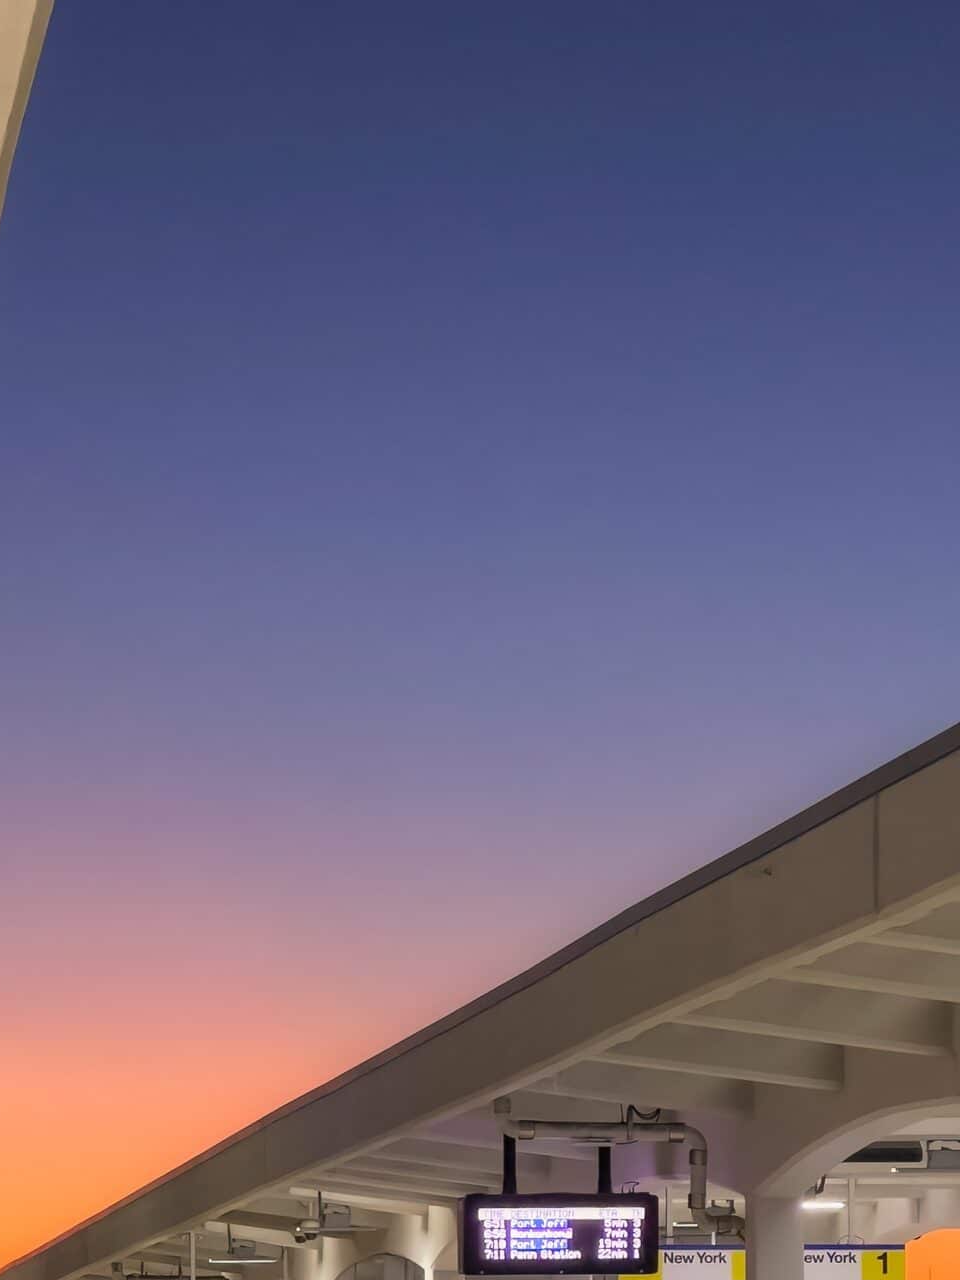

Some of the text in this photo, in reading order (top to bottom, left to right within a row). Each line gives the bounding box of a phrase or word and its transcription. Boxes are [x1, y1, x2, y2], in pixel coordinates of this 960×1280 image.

[633, 1228, 641, 1238] 3
[664, 1252, 727, 1264] New York
[826, 1252, 857, 1263] York
[877, 1252, 888, 1274] 1
